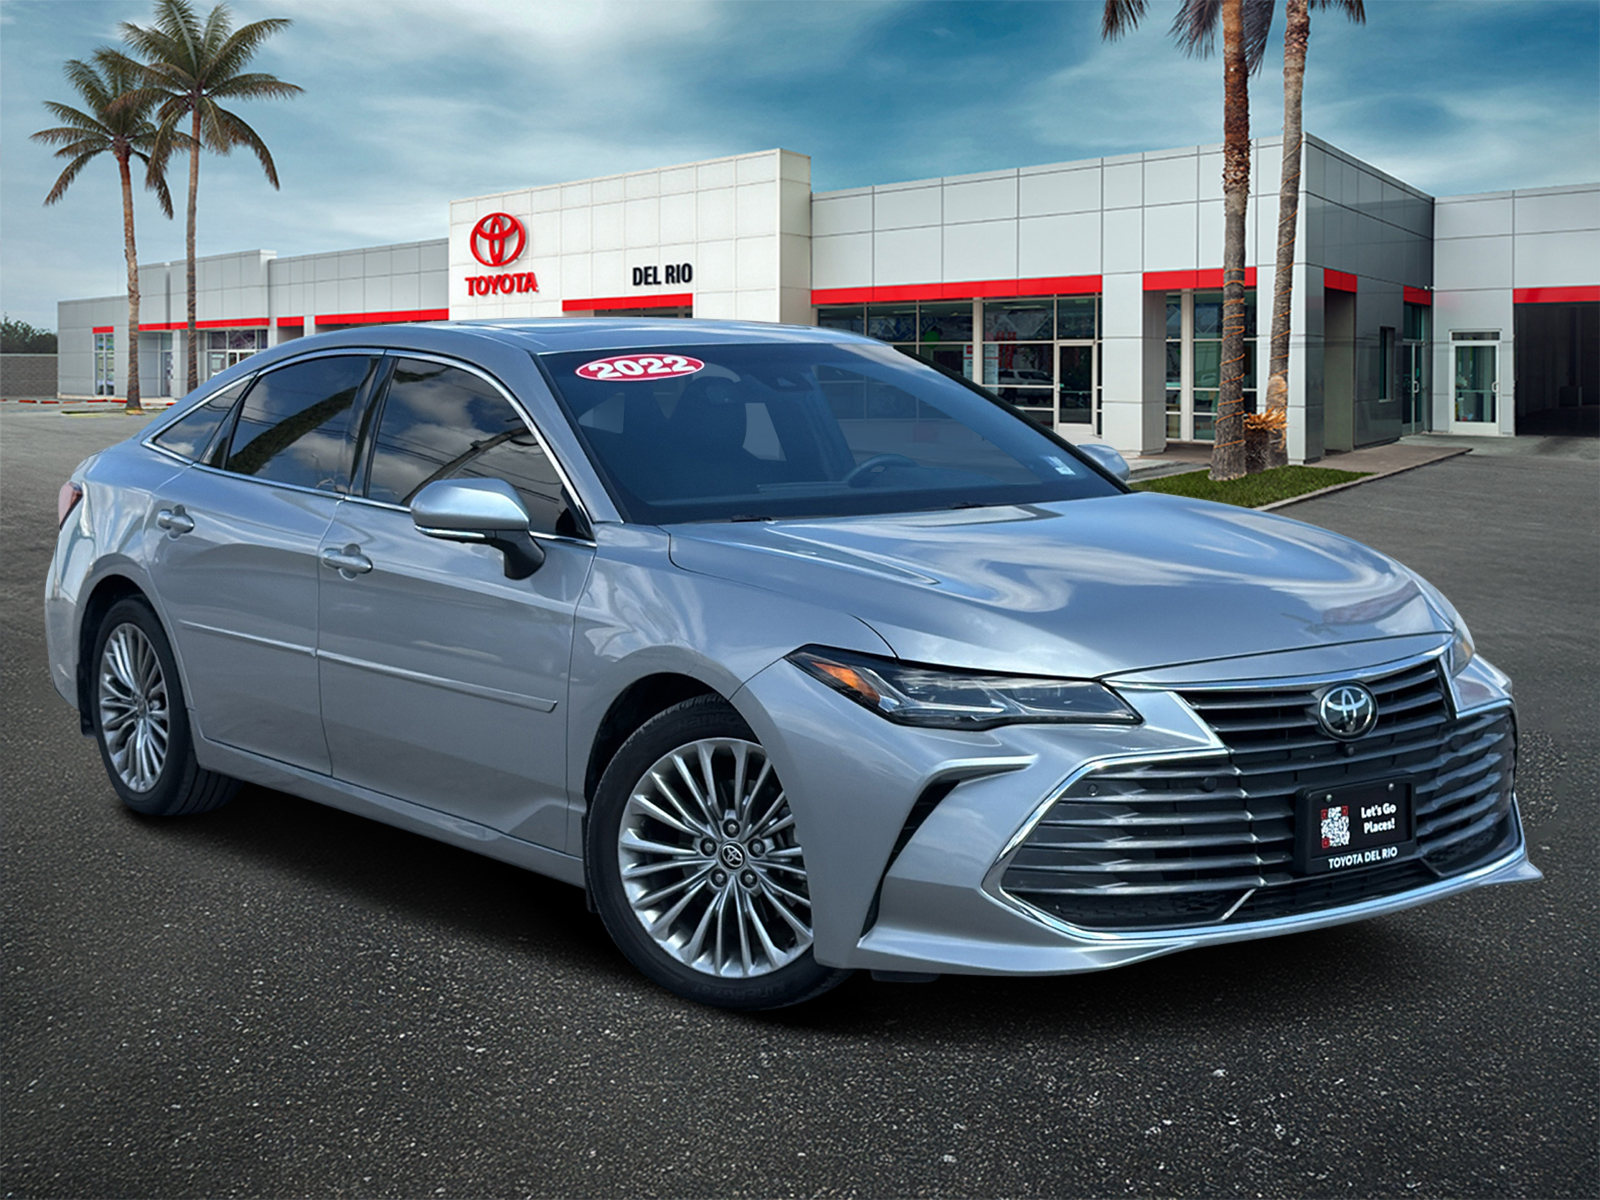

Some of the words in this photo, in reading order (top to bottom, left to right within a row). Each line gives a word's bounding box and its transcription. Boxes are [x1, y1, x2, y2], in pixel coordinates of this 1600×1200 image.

[465, 272, 538, 296] TOYOTA
[632, 266, 661, 286] DEL
[665, 263, 693, 284] RIO
[588, 356, 697, 379] 2022
[1361, 804, 1382, 818] Let's
[1382, 802, 1397, 815] Go
[1363, 817, 1395, 834] Places!
[1328, 853, 1364, 869] TOYOTA
[1364, 851, 1381, 862] DEL
[1382, 847, 1398, 858] RIO
